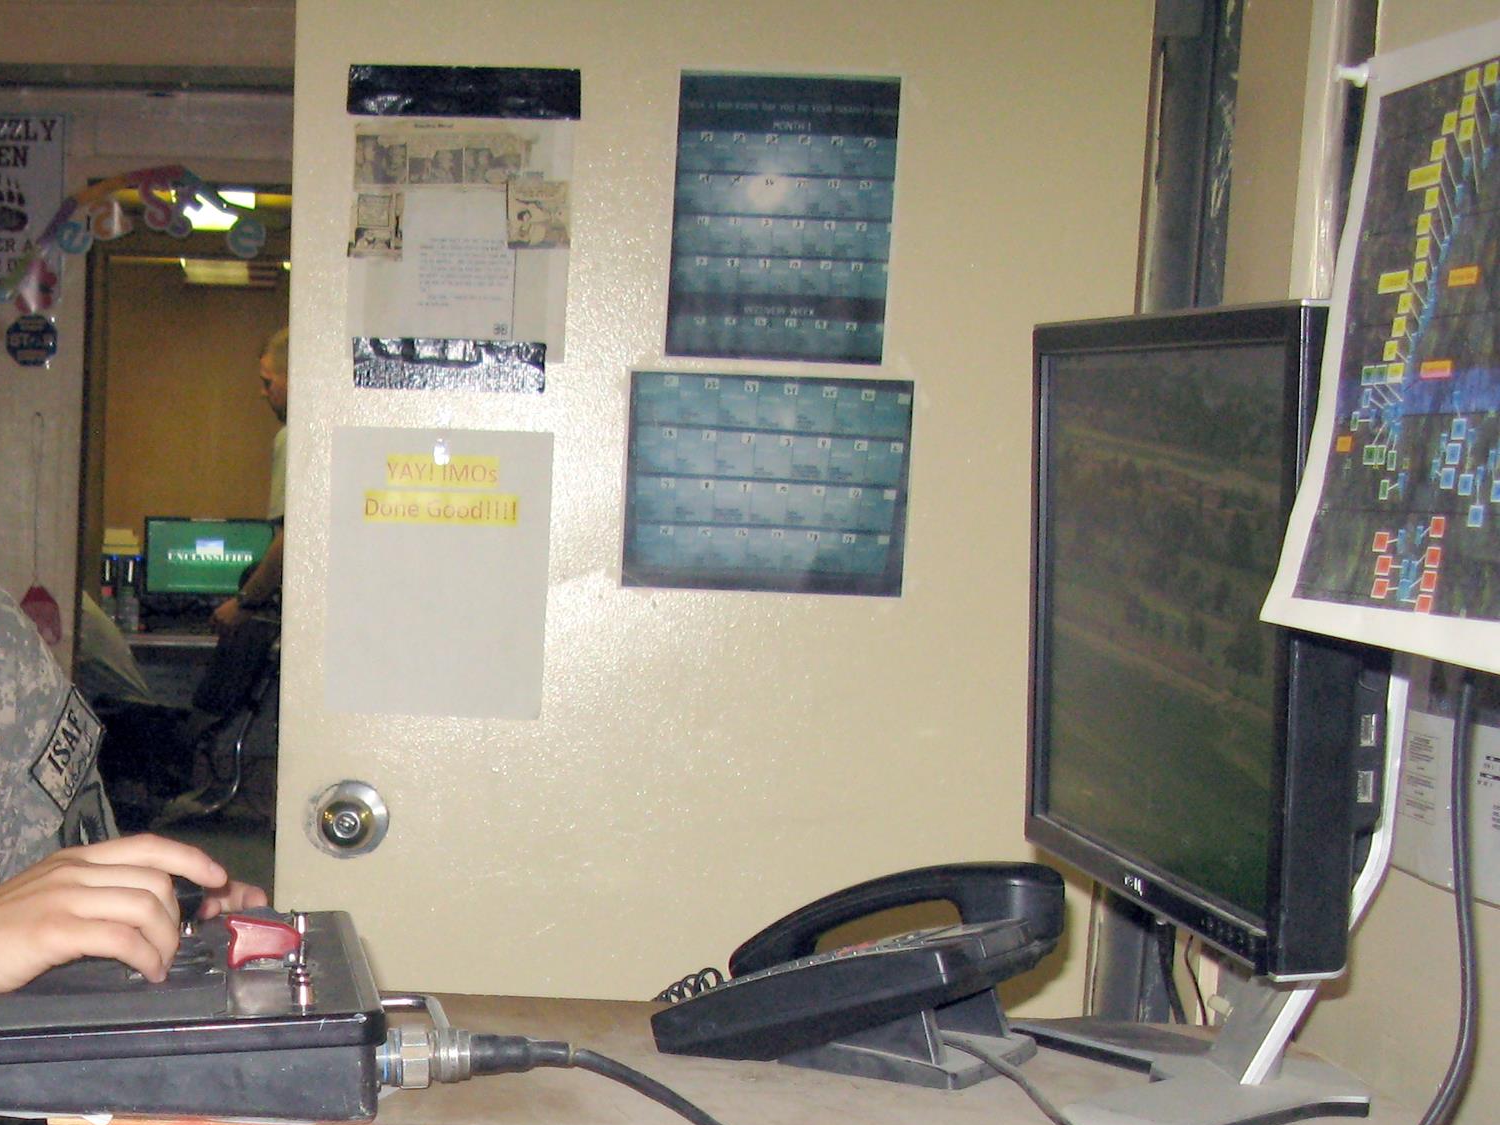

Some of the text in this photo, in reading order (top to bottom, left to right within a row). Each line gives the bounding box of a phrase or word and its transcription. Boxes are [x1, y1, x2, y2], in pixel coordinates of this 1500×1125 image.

[387, 462, 434, 482] YAY!
[364, 498, 517, 521] Done Good!!!!
[47, 708, 83, 777] ISAF
